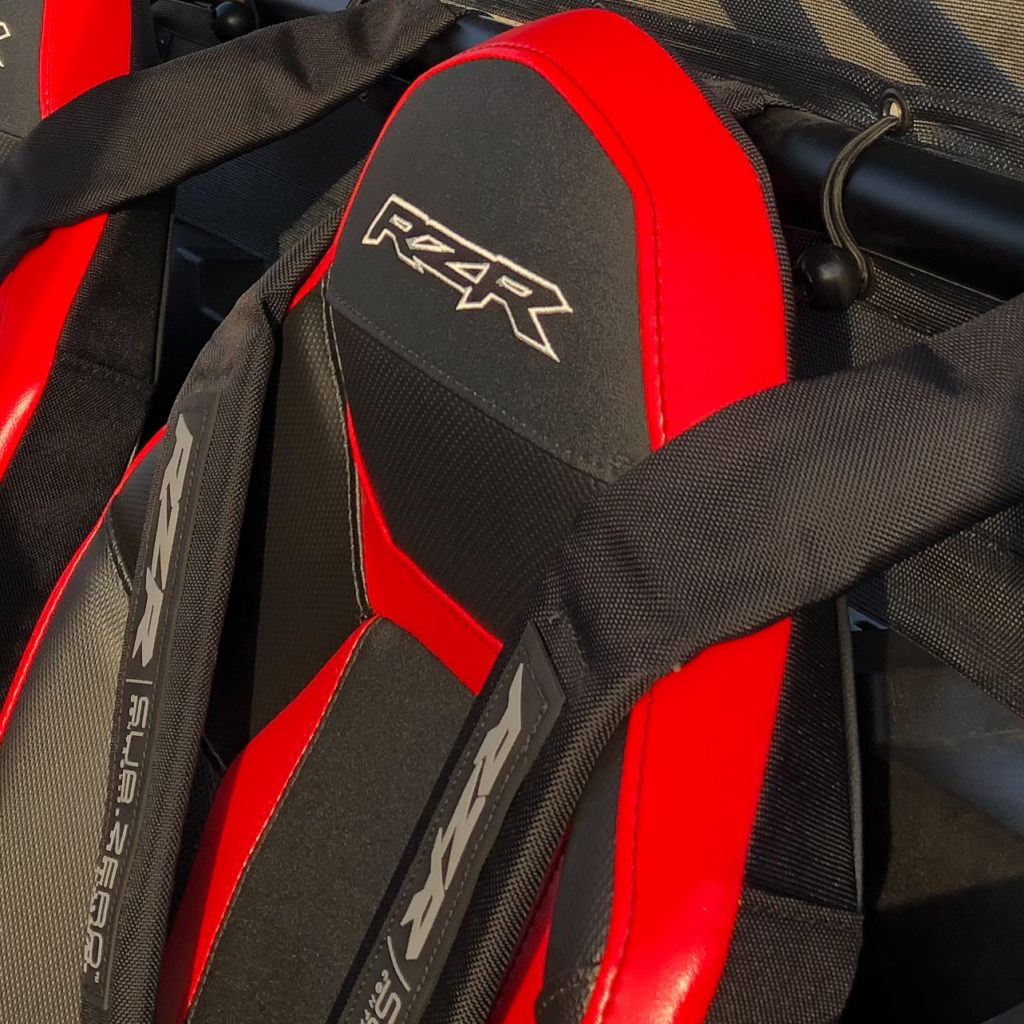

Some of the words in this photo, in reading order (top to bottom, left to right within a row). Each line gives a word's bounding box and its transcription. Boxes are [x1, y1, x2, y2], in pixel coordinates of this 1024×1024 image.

[362, 193, 573, 363] RZR
[132, 413, 194, 668] RZR
[399, 663, 524, 960] RZR
